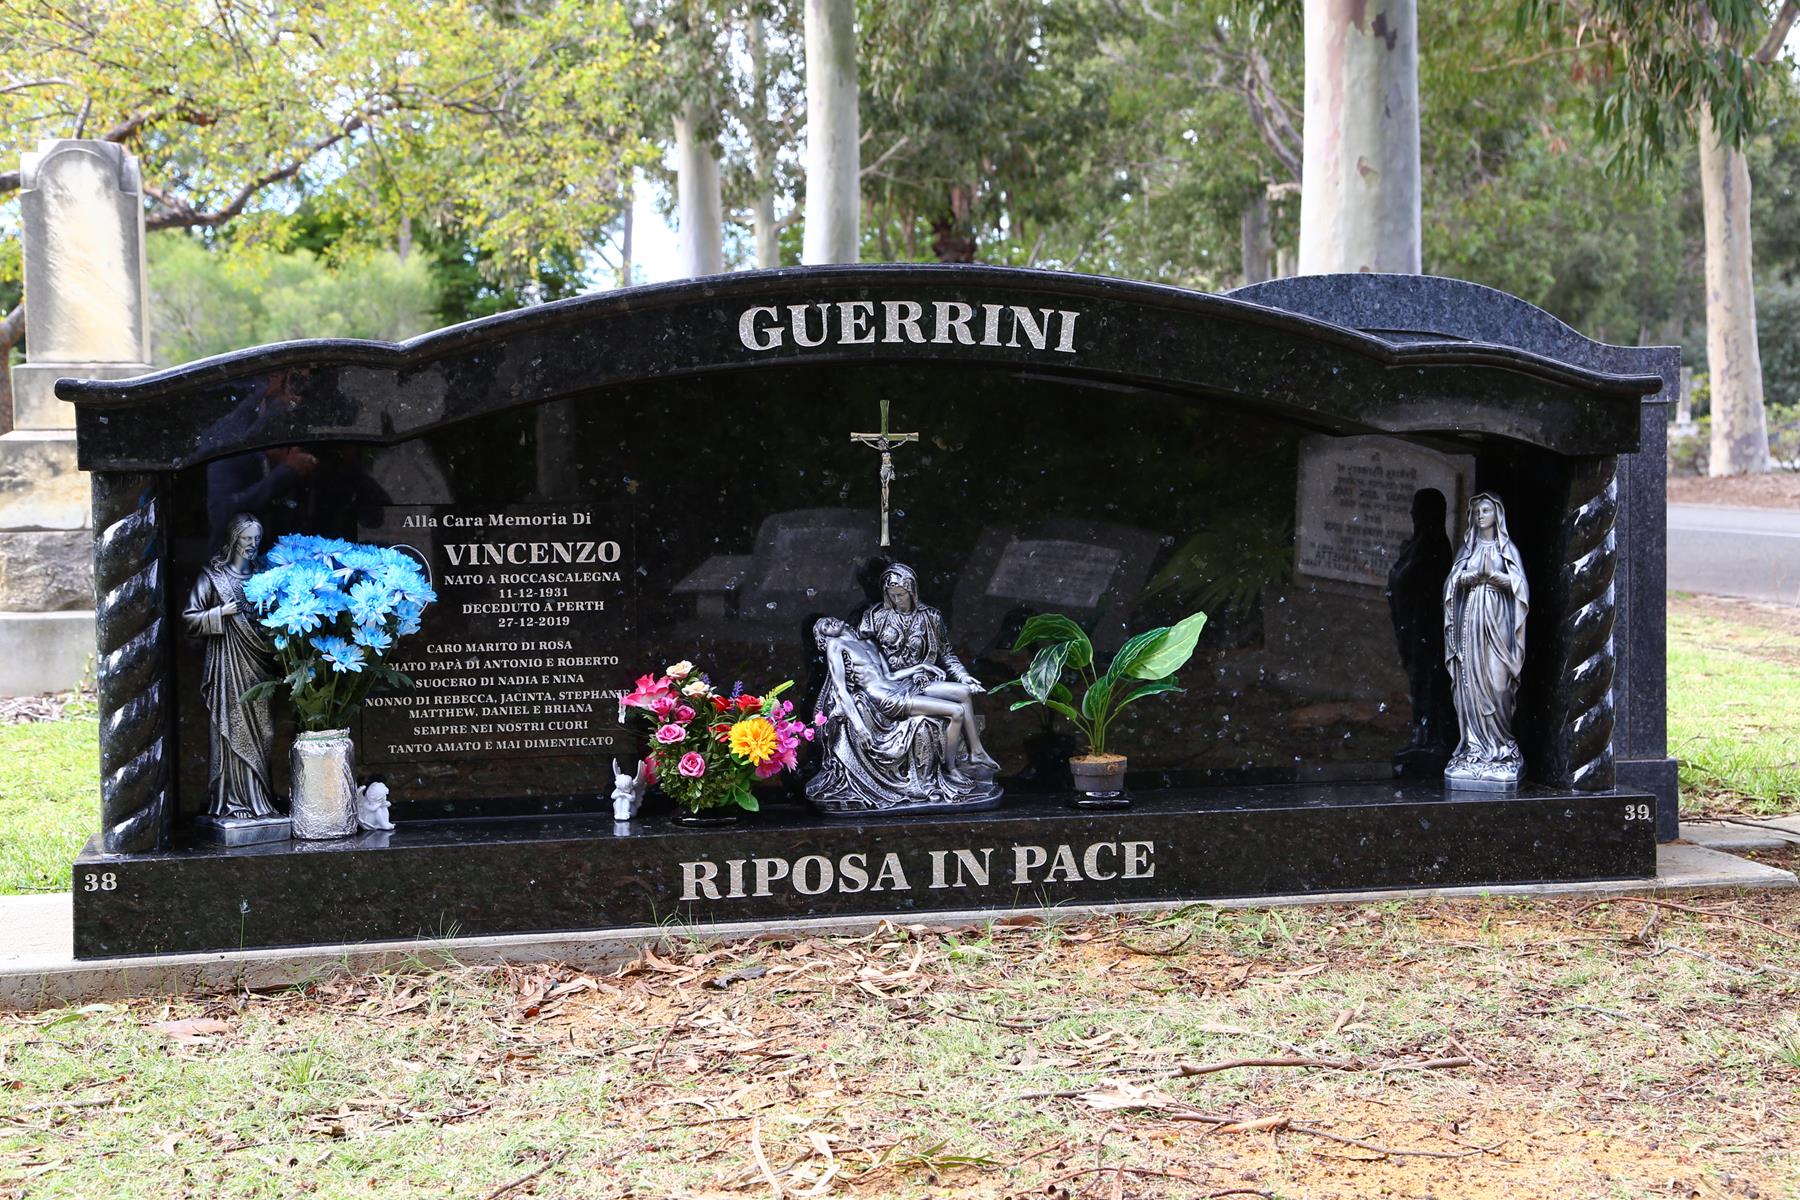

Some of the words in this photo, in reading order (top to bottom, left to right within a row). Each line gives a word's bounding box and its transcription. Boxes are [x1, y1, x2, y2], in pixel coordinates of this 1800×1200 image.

[739, 301, 1080, 354] GUERRINI
[403, 515, 437, 527] Alla
[443, 515, 483, 526] Cara
[489, 513, 566, 525] Memoria
[573, 513, 590, 524] Di
[444, 541, 620, 565] VINCENZO
[445, 575, 483, 584] NATO
[487, 575, 496, 584] A
[501, 572, 620, 583] ROCCASCALEGNA
[500, 588, 568, 598] 11-12-1931
[463, 603, 540, 613] DECEDUTO
[544, 603, 552, 611] A
[557, 601, 604, 611] PERTH
[499, 617, 569, 627] 27-12-2019
[427, 644, 461, 653] CARO
[466, 642, 517, 652] MARITO
[522, 642, 534, 650] DI
[539, 641, 572, 649] ROSA
[389, 662, 426, 671] MATO
[431, 659, 462, 670] PAPÀ
[466, 660, 479, 669] DI
[484, 659, 542, 668] ANTONIO
[547, 658, 553, 666] E
[558, 656, 618, 666] ROBERTO
[416, 678, 476, 688] SUOCERO
[481, 677, 494, 685] DI
[498, 676, 538, 685] NADIA
[553, 675, 584, 683] NINA
[366, 697, 411, 706] NONNO
[416, 697, 429, 705] DI
[482, 706, 529, 715] DANIEL
[545, 704, 592, 713] BRIANA
[414, 725, 467, 735] SEMPRE
[471, 725, 492, 733] NEI
[497, 723, 544, 732] NOSTRI
[549, 721, 587, 730] CUORI
[388, 744, 431, 753] TANTO
[436, 742, 480, 751] AMATO
[497, 741, 520, 749] MAI
[525, 737, 613, 748] DIMENTICATO
[1624, 804, 1650, 821] 39
[679, 853, 912, 903] RIPOSA
[929, 848, 994, 888] IN
[1010, 841, 1155, 886] PACE
[85, 873, 117, 891] 38
